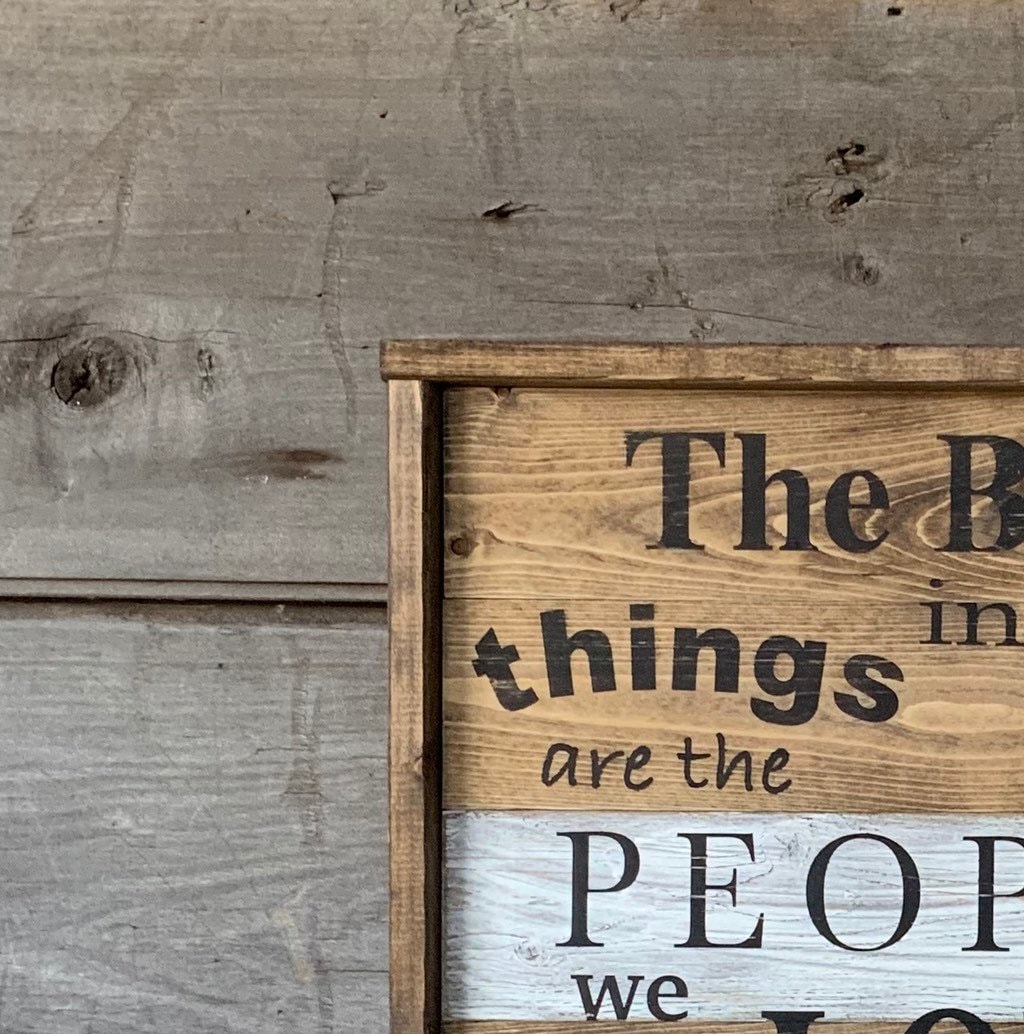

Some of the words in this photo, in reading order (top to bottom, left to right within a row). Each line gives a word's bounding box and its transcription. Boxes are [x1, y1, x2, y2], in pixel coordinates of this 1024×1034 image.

[626, 433, 886, 550] The
[922, 580, 1023, 646] in
[472, 605, 905, 723] things
[543, 742, 651, 787] are
[675, 733, 791, 793] the
[572, 973, 687, 1021] we
